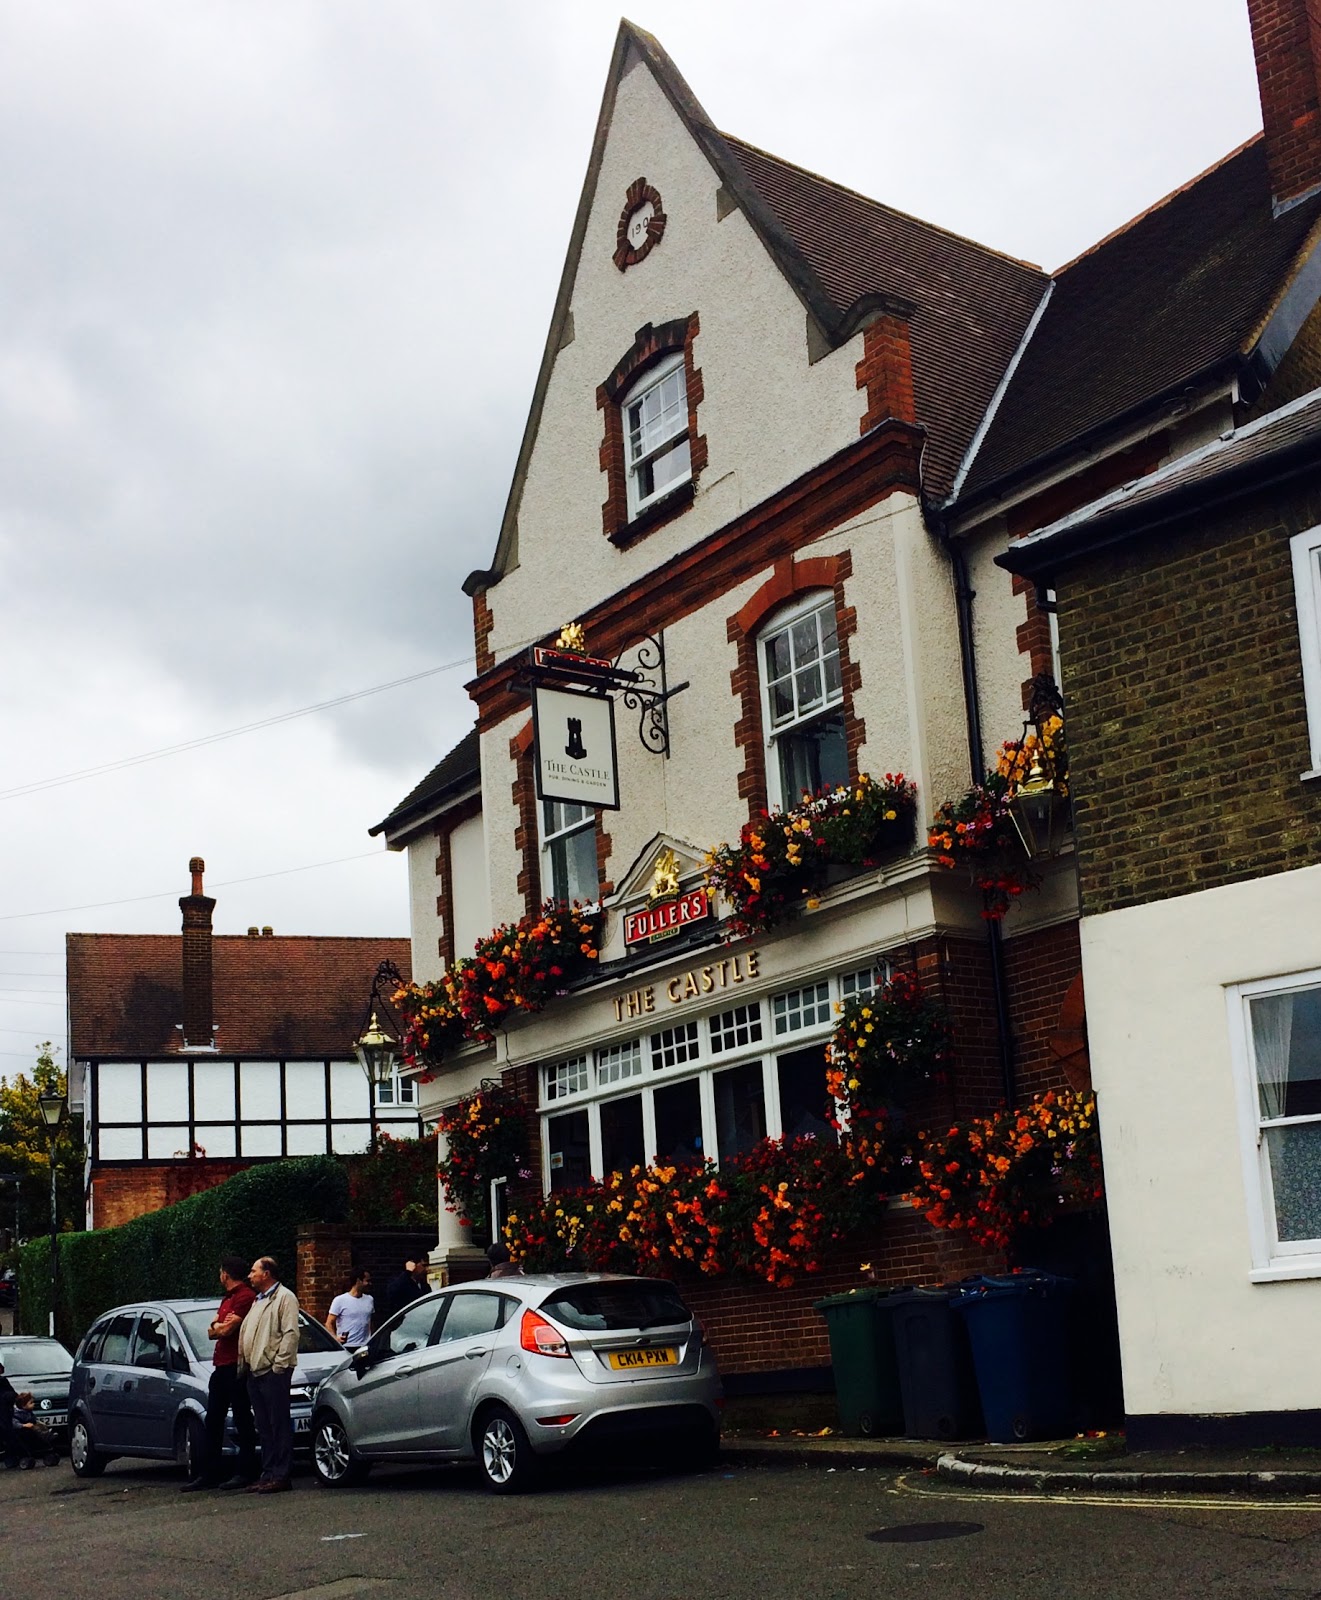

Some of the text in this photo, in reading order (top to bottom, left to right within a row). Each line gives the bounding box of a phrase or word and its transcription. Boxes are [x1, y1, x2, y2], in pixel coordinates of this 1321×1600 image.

[544, 759, 610, 780] THE CASTLE
[627, 895, 702, 939] FULLER'S
[612, 950, 759, 1022] THE CASTLE
[617, 1351, 644, 1366] CK14
